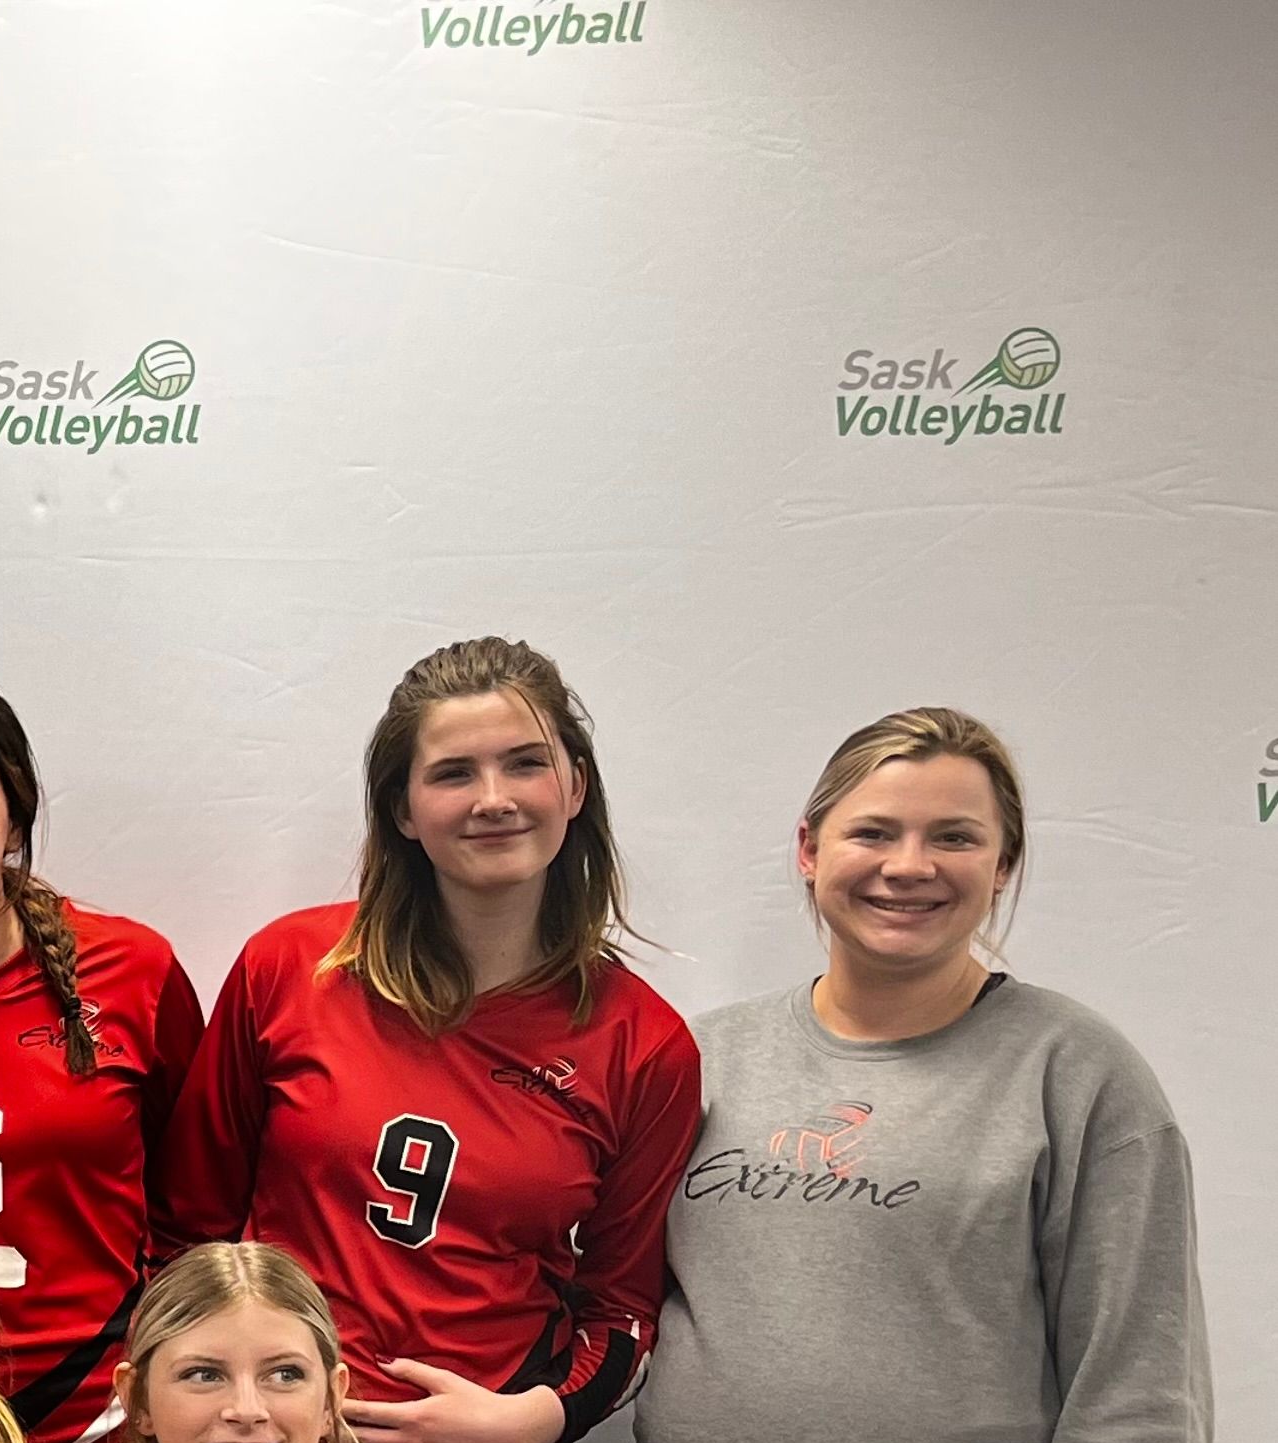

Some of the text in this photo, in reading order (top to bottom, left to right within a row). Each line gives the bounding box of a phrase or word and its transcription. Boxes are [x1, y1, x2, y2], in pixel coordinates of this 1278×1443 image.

[421, 0, 648, 57] Volleyball
[837, 348, 959, 391] Sask
[836, 392, 1066, 446] Volleyball
[366, 1113, 459, 1250] 9
[684, 1148, 921, 1209] Extreme
